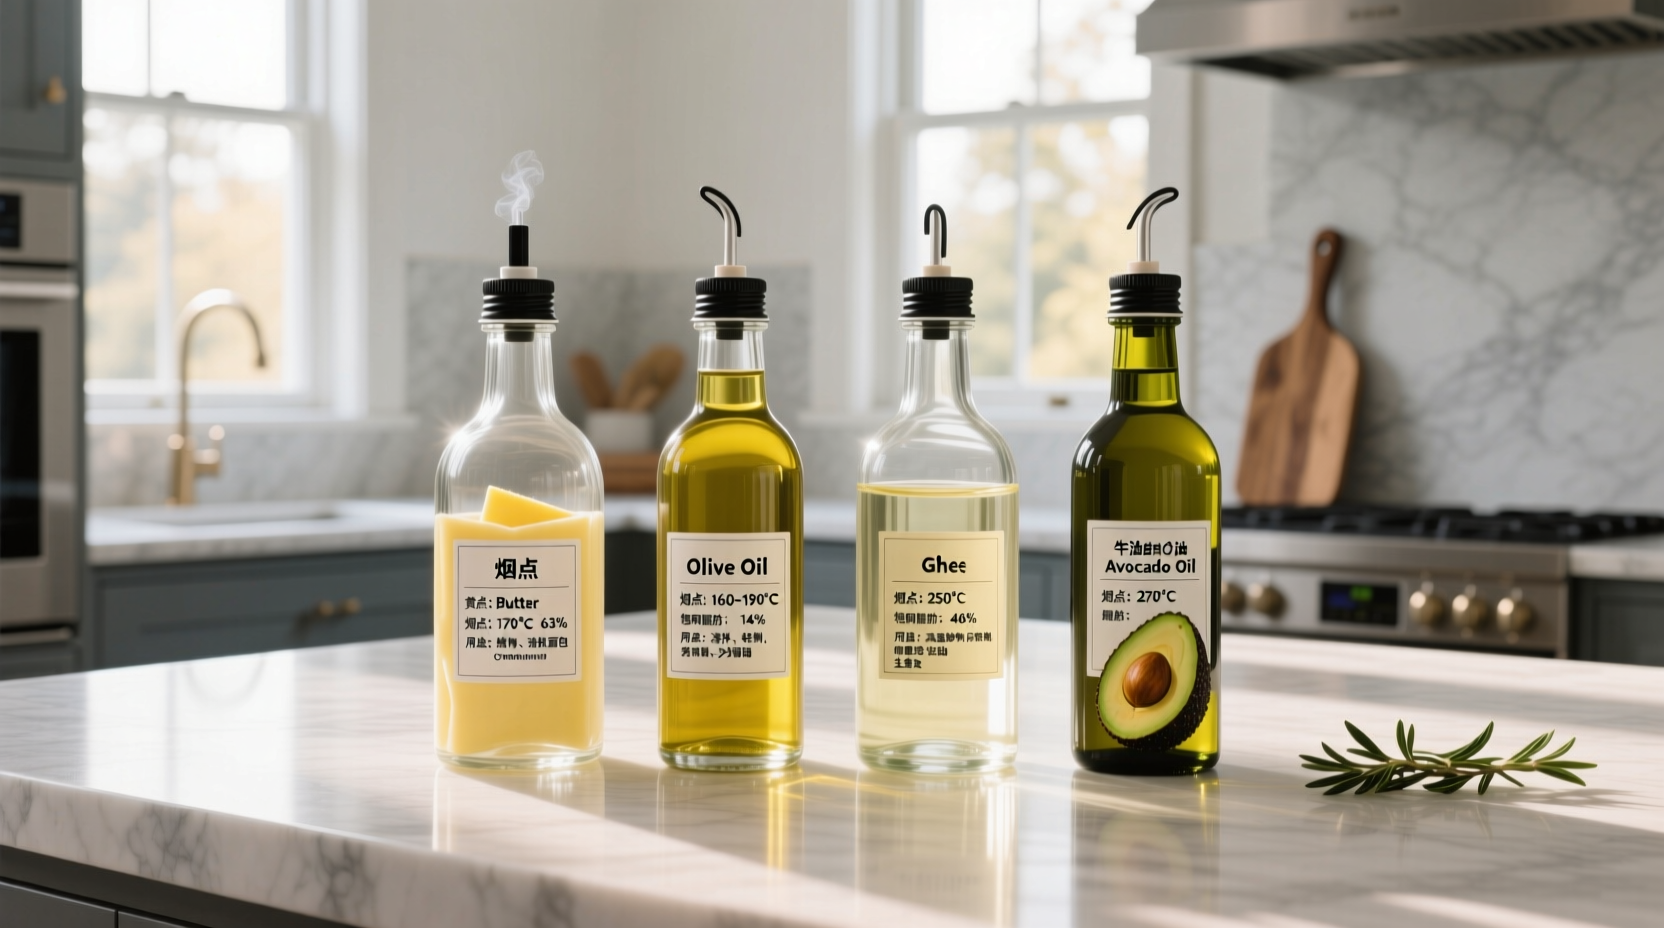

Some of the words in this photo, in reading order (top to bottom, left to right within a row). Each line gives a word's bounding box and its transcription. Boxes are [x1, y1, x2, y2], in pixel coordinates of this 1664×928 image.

[495, 558, 538, 580] 烟点
[687, 558, 735, 575] Olive
[741, 557, 768, 575] Oil
[922, 555, 966, 573] Ghee
[1105, 559, 1171, 573] Avocado
[1176, 558, 1195, 573] Oil
[496, 597, 539, 609] Butter
[928, 591, 966, 604] 250°C
[1137, 589, 1176, 603] 270°C
[541, 617, 567, 628] 63%
[741, 614, 766, 625] 14%
